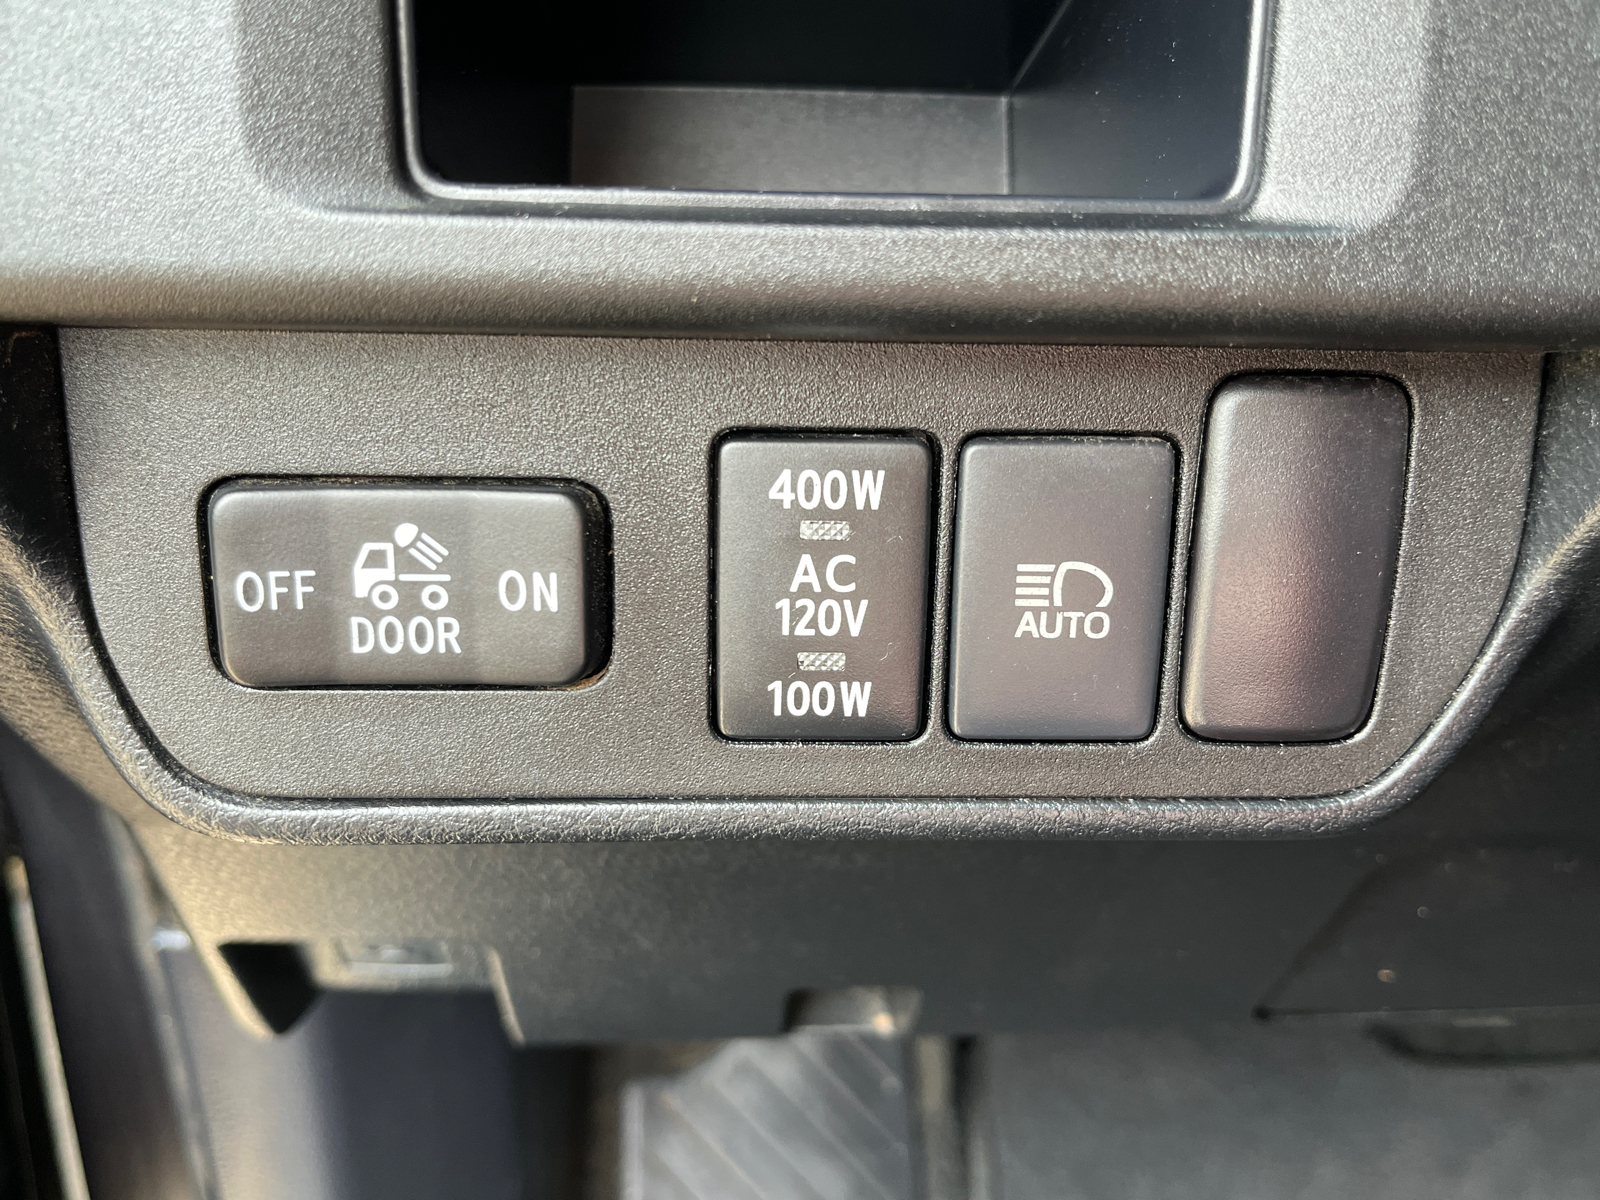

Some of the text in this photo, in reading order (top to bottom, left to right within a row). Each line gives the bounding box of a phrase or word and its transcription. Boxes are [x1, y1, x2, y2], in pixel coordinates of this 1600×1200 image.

[768, 468, 886, 511] 400W
[235, 569, 316, 613] OFF
[498, 569, 559, 612] ON
[789, 553, 857, 593] AC
[350, 615, 462, 655] DOOR
[775, 598, 869, 637] 120V
[1014, 610, 1111, 639] AUTO
[767, 680, 873, 717] 100W
